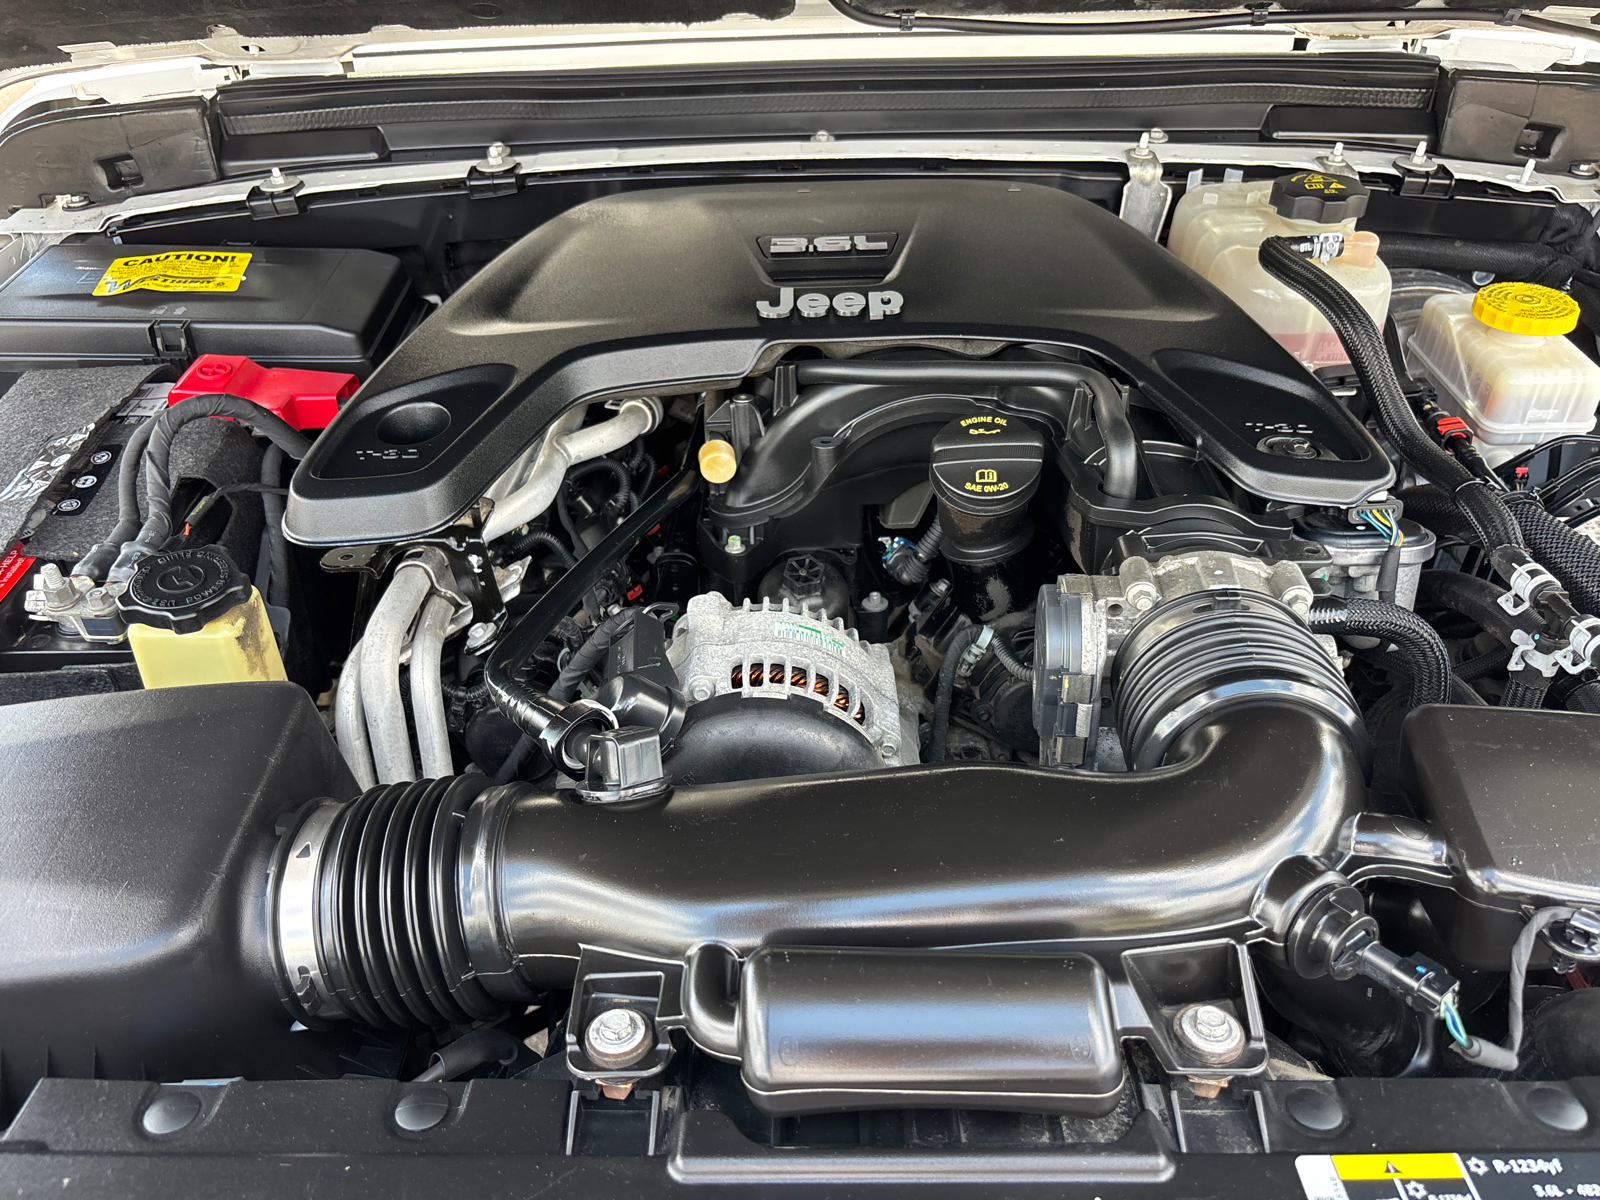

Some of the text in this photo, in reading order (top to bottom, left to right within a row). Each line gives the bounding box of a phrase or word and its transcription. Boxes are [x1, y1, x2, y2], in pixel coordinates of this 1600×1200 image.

[770, 235, 888, 253] 3.6L
[122, 253, 237, 267] CAUTION!
[756, 287, 904, 320] Jeep
[960, 416, 1008, 427] ENGINE OIL
[964, 482, 1009, 493] SAE 0W-20
[158, 550, 194, 564] FLUID
[196, 551, 230, 580] STEERING
[185, 580, 226, 604] POWER
